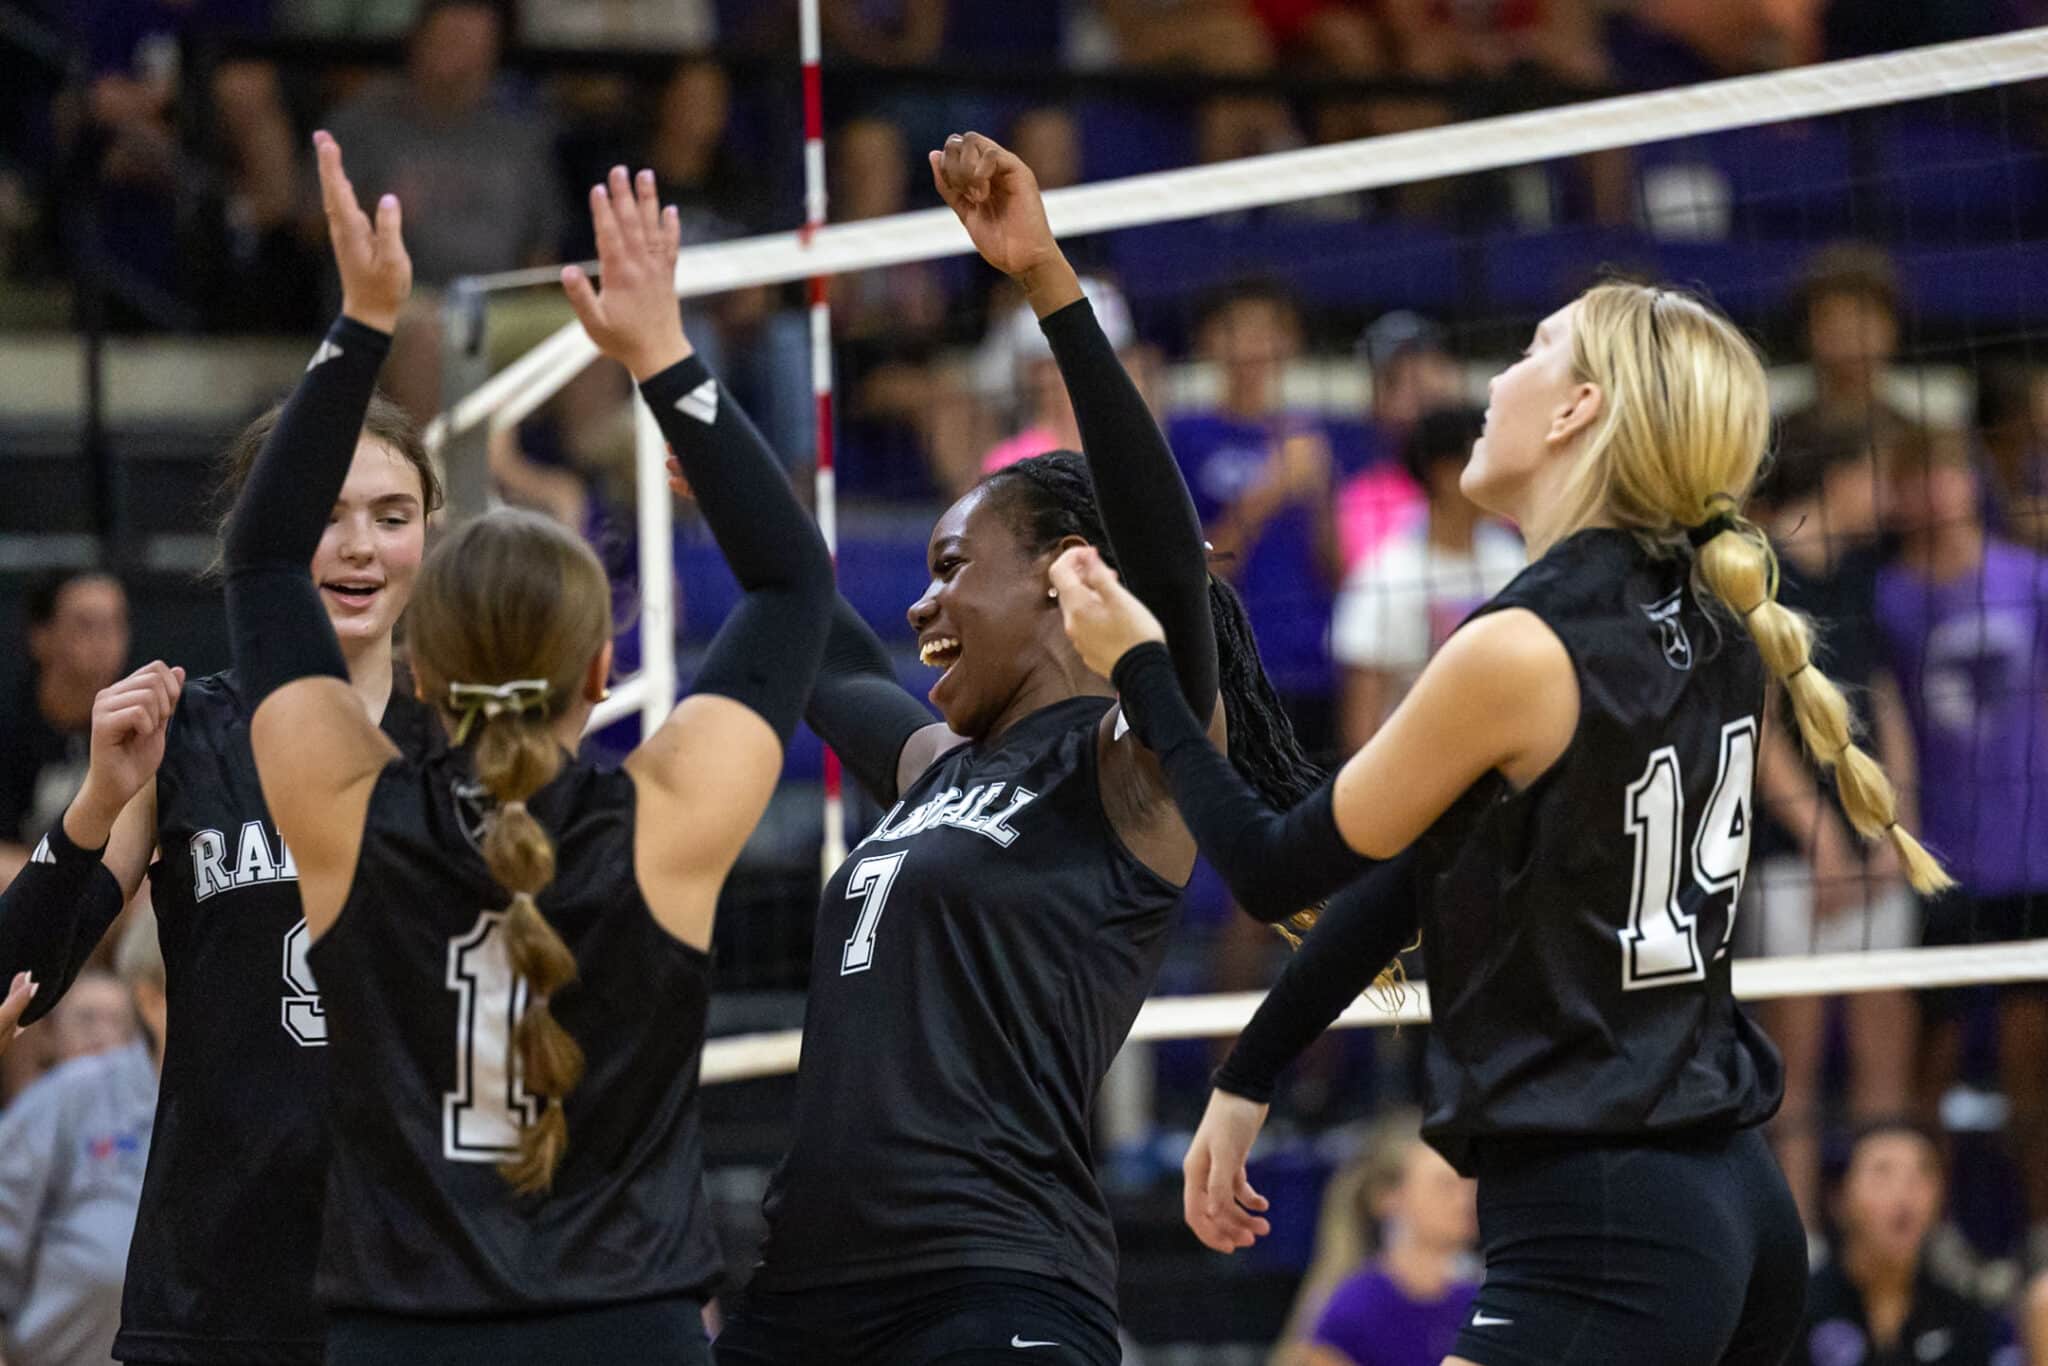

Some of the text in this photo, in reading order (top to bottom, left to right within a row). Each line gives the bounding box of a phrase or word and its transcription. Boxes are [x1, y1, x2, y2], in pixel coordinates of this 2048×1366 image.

[840, 849, 909, 976] 7
[1617, 715, 1757, 990] 14
[443, 909, 537, 1163] 1
